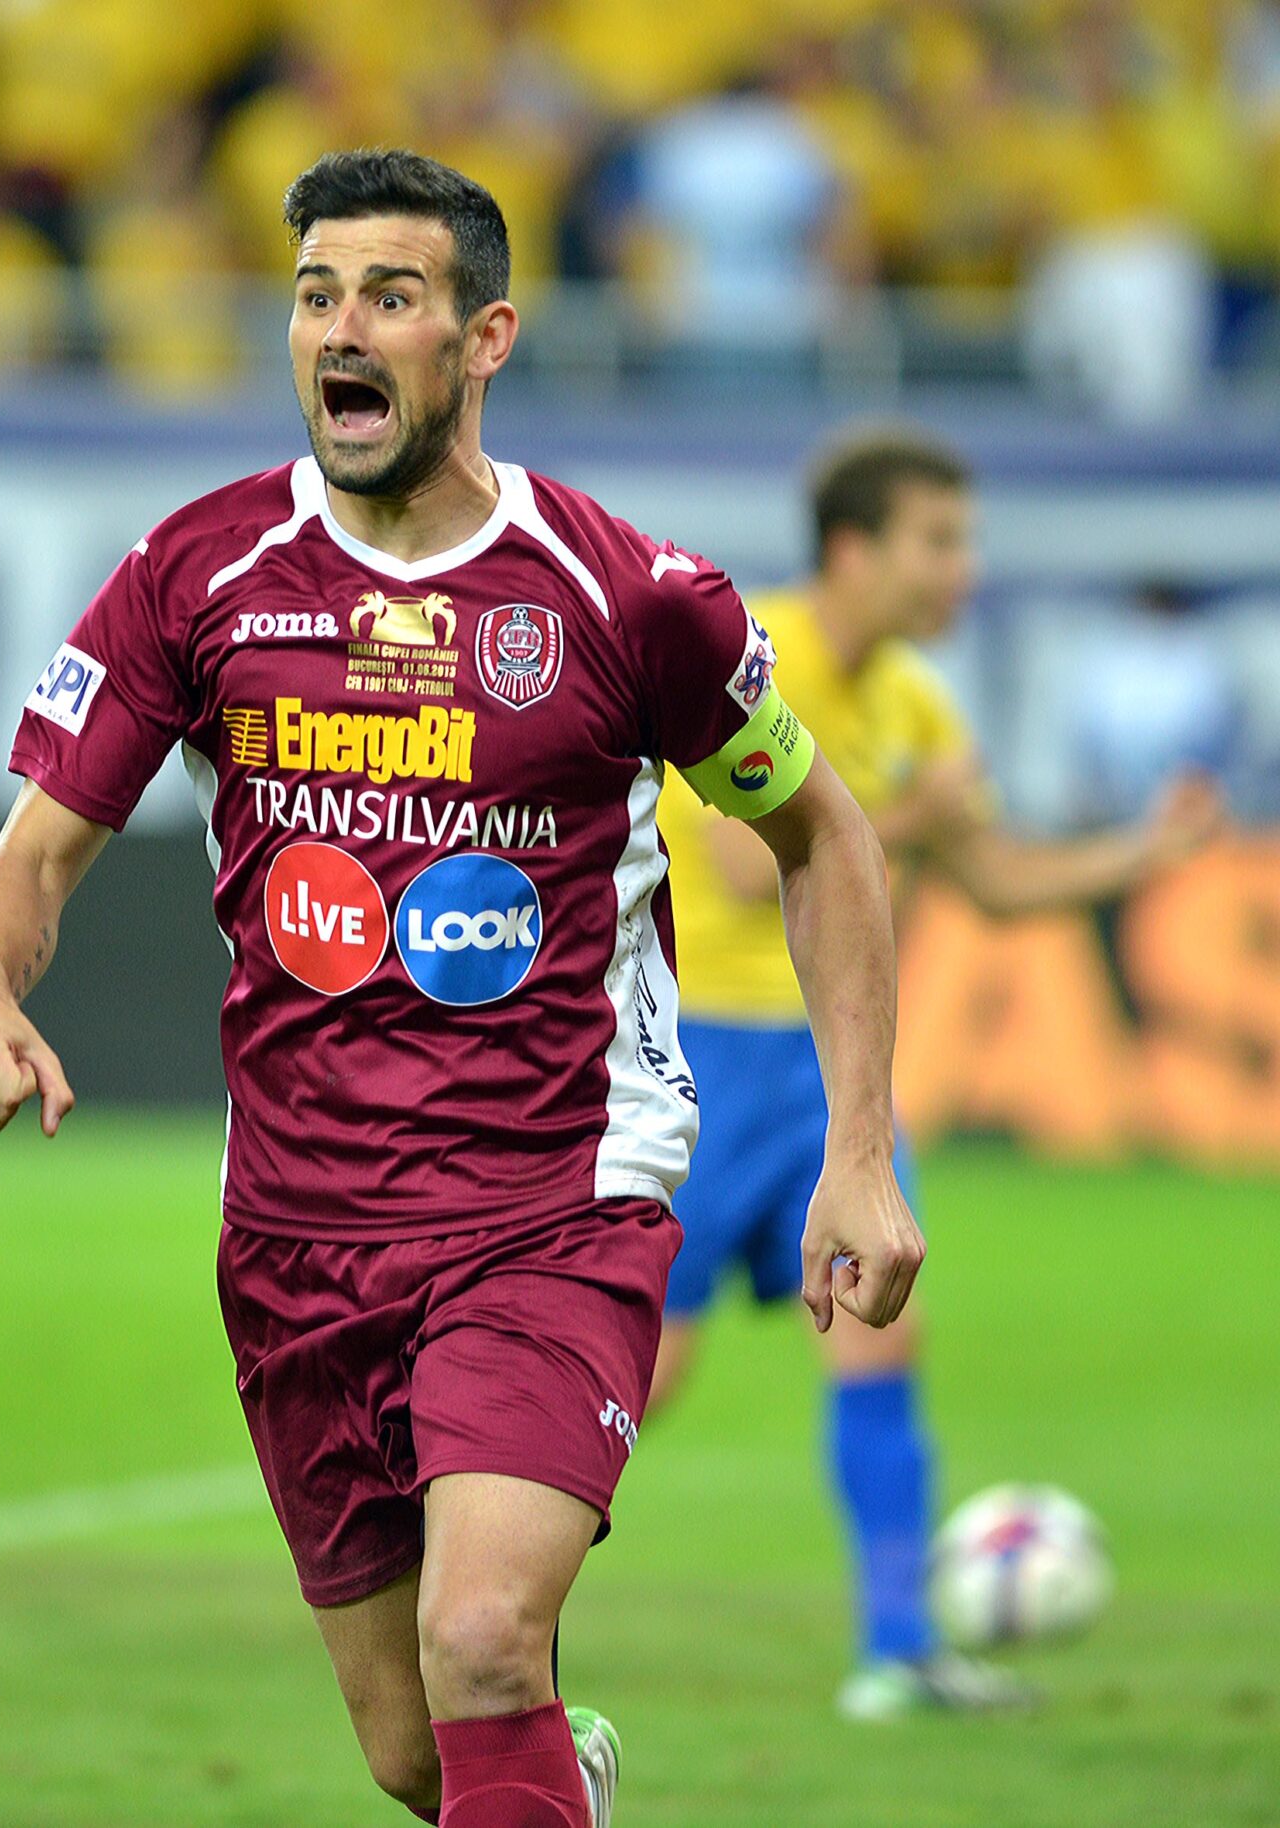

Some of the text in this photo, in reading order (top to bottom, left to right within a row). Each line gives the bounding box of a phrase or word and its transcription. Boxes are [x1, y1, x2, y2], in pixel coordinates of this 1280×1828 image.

[348, 642, 380, 657] FINALA
[381, 644, 410, 659] CUPEI
[345, 675, 363, 691] CFR
[364, 676, 387, 692] 1907
[387, 677, 409, 693] CLUJ
[414, 679, 455, 697] PETROLUL
[402, 662, 457, 679] 01.06.2013
[275, 697, 477, 784] EnergoBit
[246, 776, 557, 848] TRANSILVANIA
[408, 904, 538, 953] LOOK
